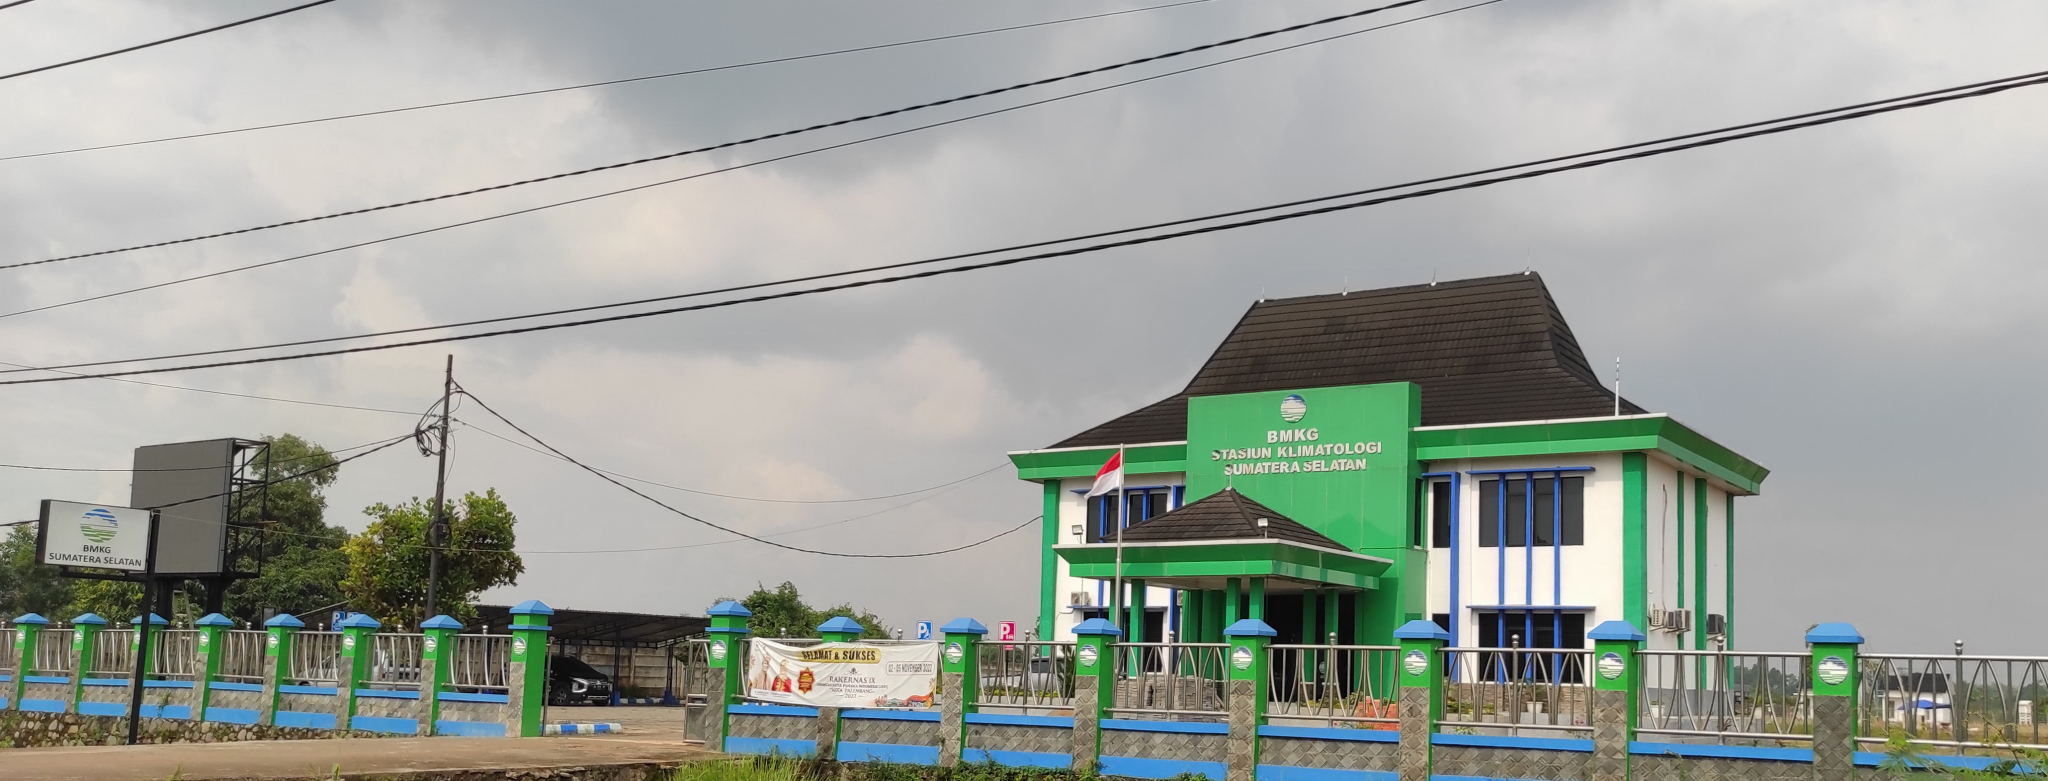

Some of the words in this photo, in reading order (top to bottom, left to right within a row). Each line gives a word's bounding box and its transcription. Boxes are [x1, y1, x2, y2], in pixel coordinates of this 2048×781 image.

[1267, 428, 1319, 444] BMKG
[1211, 447, 1272, 462] STASIUN
[1277, 441, 1382, 458] KLIMATOLOGI
[1224, 460, 1301, 476] SUMATERA
[1303, 458, 1367, 473] SELATAN
[83, 544, 111, 554] BMKG
[49, 552, 101, 564] SUMATERA
[103, 556, 142, 567] SELATAN
[918, 622, 927, 638] P
[1000, 623, 1010, 640] P
[802, 650, 832, 660] SELAMAT
[834, 652, 840, 660] &
[843, 650, 876, 661] SUKSES
[902, 663, 922, 672] NOVEMBER
[829, 675, 867, 684] RAKERNAS
